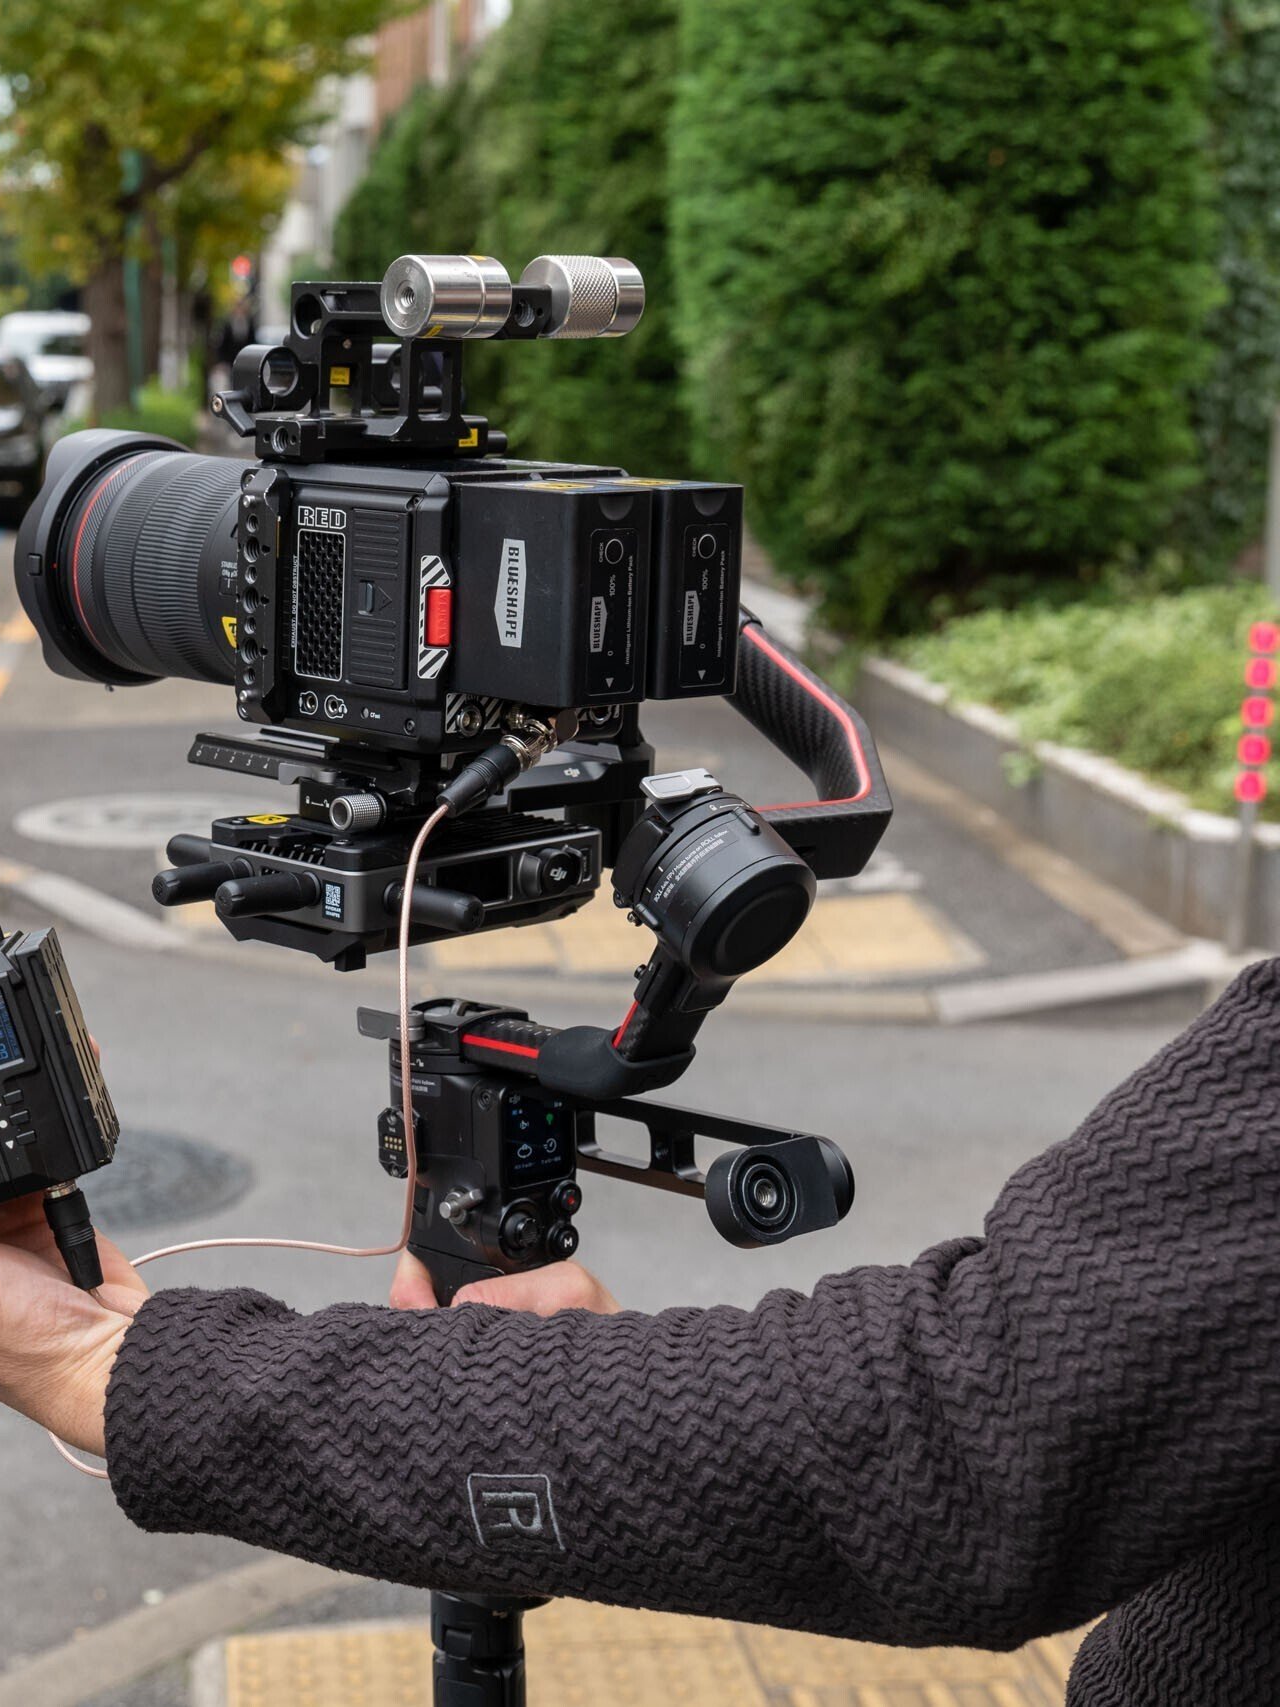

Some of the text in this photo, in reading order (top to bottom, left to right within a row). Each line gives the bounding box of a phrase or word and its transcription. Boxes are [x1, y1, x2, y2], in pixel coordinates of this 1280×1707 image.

[298, 505, 346, 530] RED
[505, 546, 520, 639] BLUESHAPE
[593, 600, 602, 649] BLUESHAPE
[686, 594, 695, 642] BLUESHAPE
[563, 1236, 573, 1249] M
